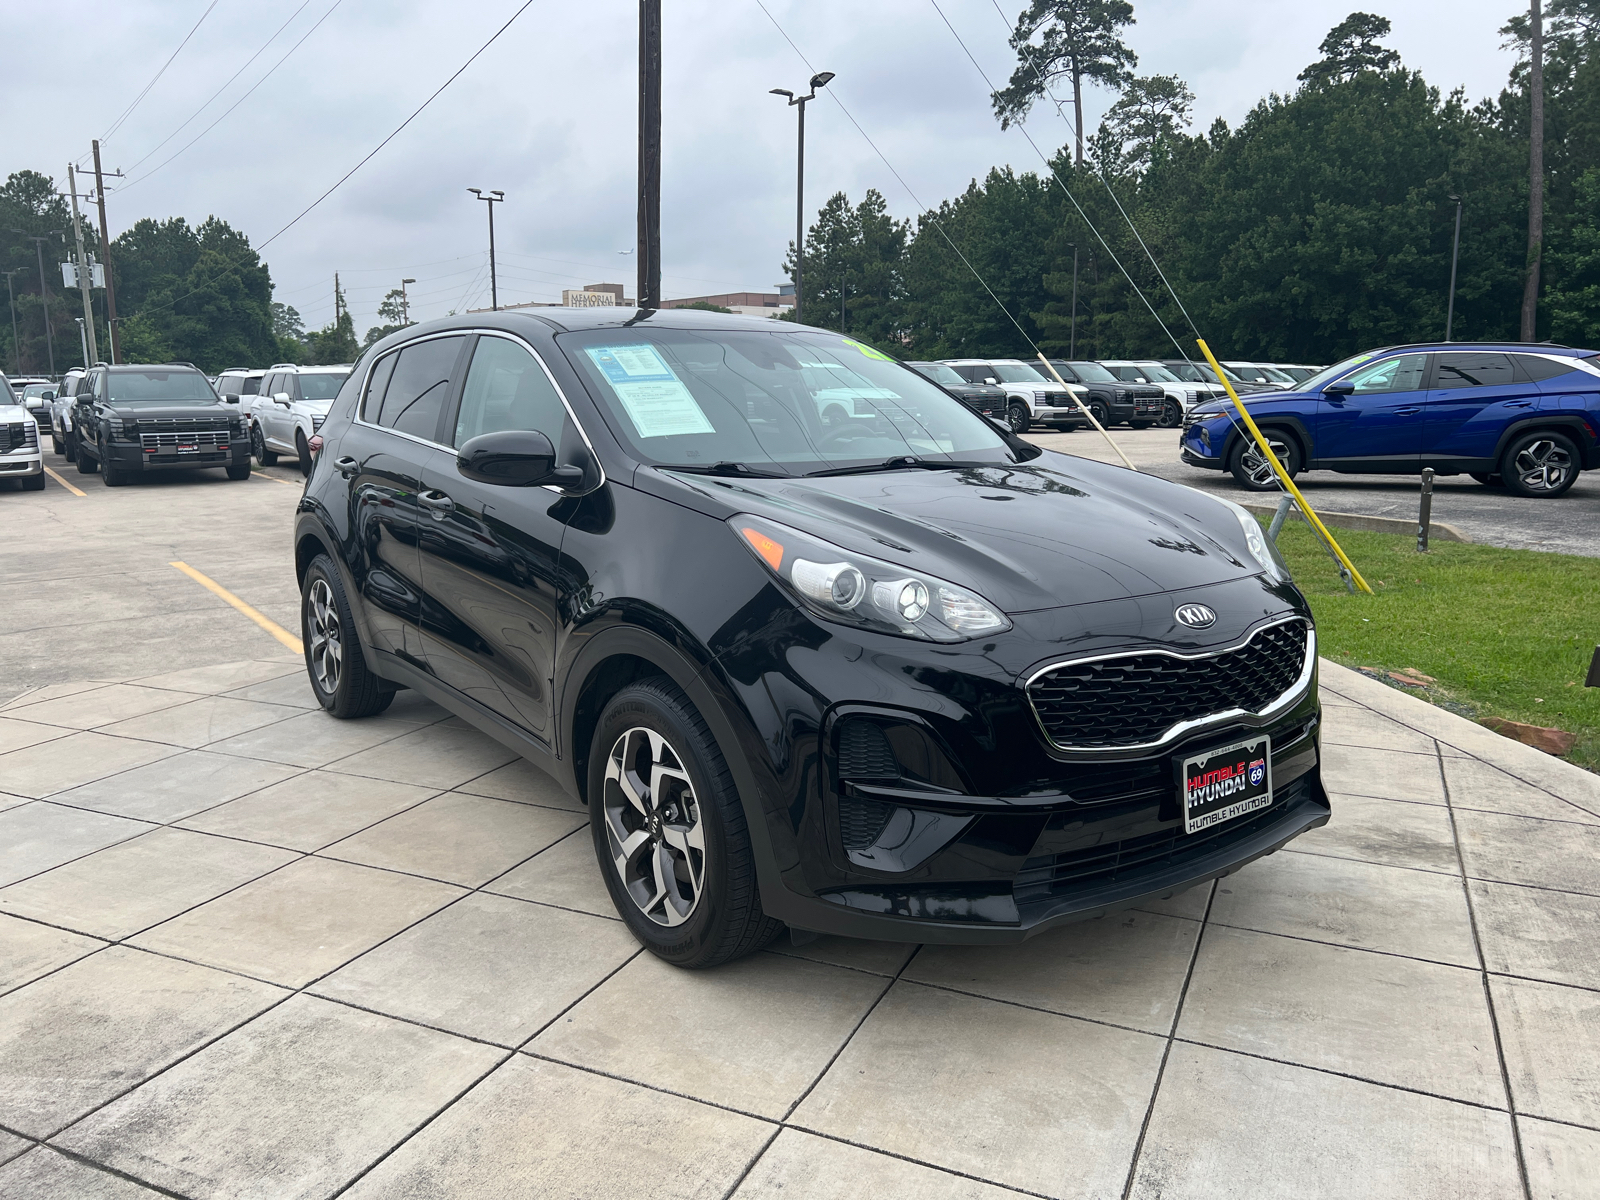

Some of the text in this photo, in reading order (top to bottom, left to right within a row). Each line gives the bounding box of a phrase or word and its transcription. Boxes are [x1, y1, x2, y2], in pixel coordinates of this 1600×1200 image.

[571, 294, 614, 303] MEMORIAL
[1180, 606, 1214, 625] KIA
[1188, 761, 1246, 792] HUMBLE
[1251, 768, 1262, 782] 69
[1188, 774, 1246, 809] HYUNDAI
[1189, 795, 1269, 832] HUMBLE HYUNDAI
[651, 815, 659, 834] KIA
